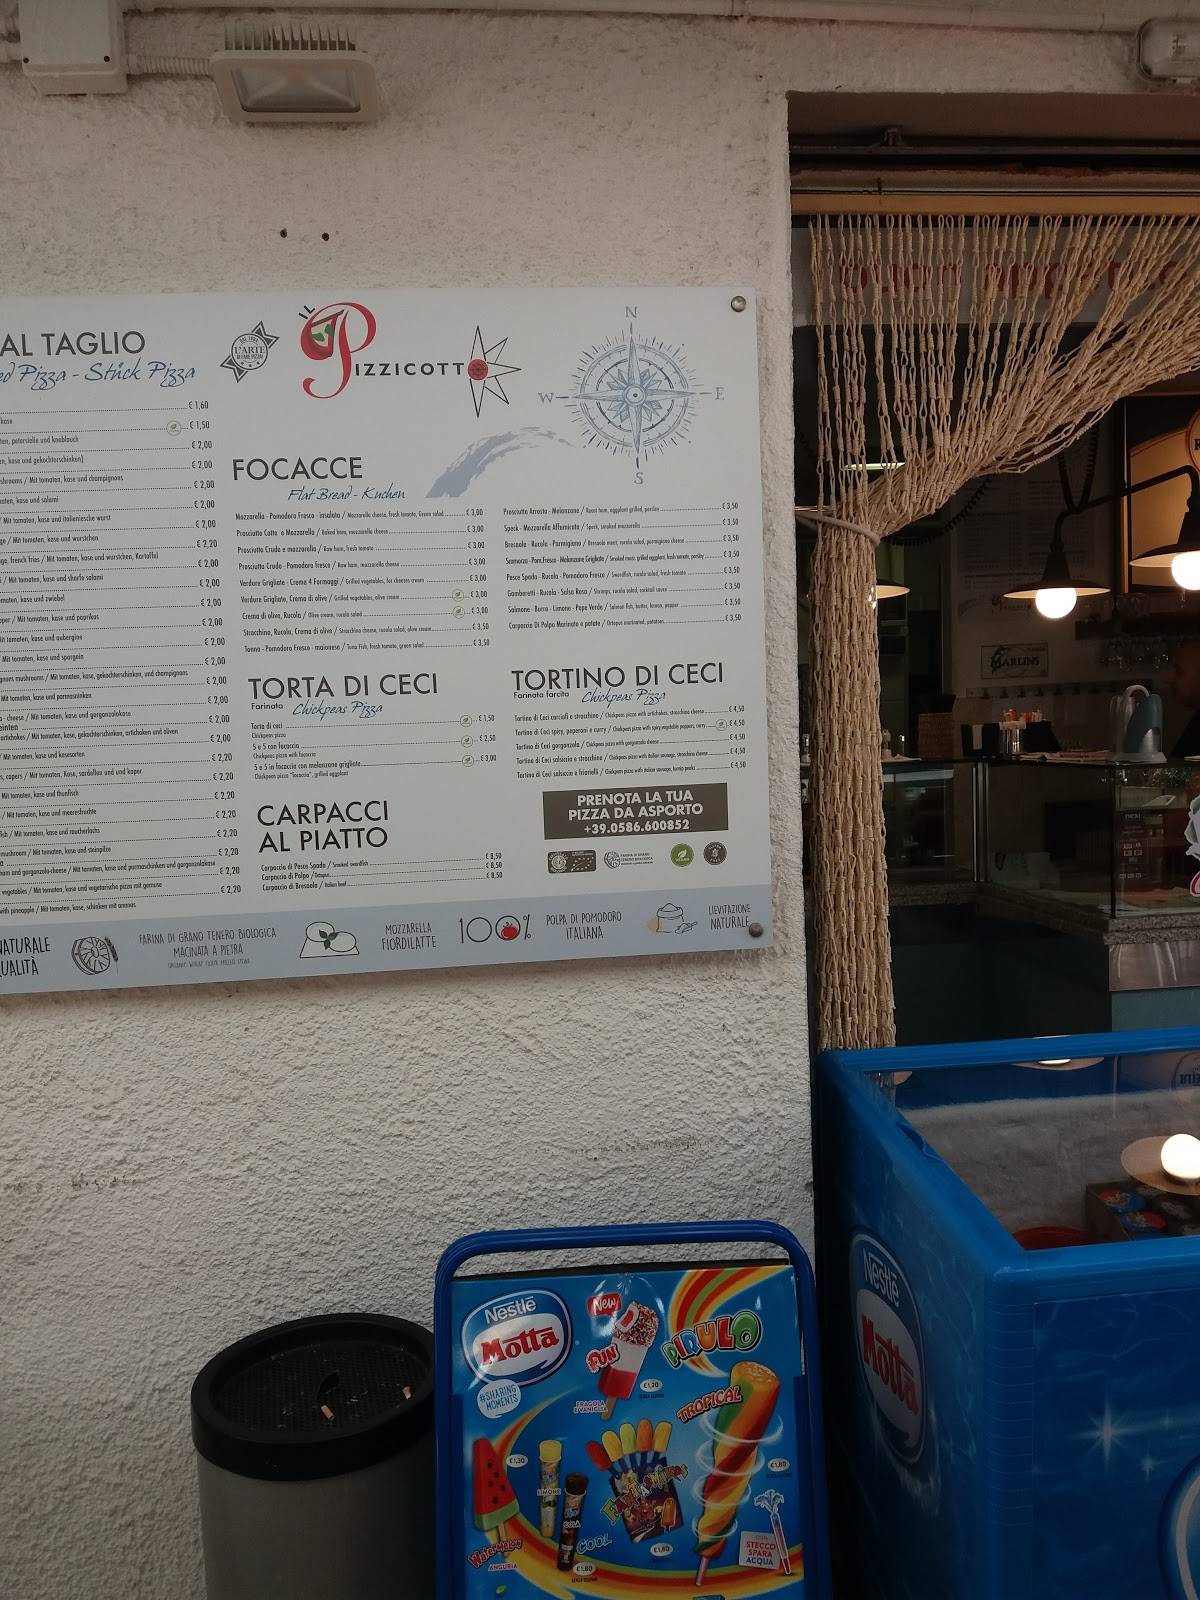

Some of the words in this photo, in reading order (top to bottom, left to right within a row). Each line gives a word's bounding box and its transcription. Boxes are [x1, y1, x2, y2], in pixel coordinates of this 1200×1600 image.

[298, 304, 316, 319] IL
[625, 306, 637, 318] N
[0, 333, 33, 356] AL
[41, 331, 145, 356] TAGLIO
[18, 364, 66, 390] Pizza
[148, 361, 195, 387] Pizza
[537, 392, 555, 403] W
[715, 387, 724, 399] E
[195, 401, 208, 410] 1,60
[196, 421, 210, 430] 1,50
[198, 441, 212, 449] 2,00
[233, 457, 362, 480] FOCACCE
[634, 472, 643, 485] S
[288, 485, 315, 500] Flat
[317, 485, 351, 500] Bread
[361, 483, 405, 499] Kuchen
[504, 524, 519, 532] Speck
[309, 576, 312, 584] 4
[476, 574, 487, 582] 3,00
[512, 666, 625, 691] TORTINO
[635, 665, 658, 685] DI
[669, 662, 723, 685] CECI
[248, 676, 334, 700] TORTA
[344, 675, 369, 696] DI
[380, 673, 438, 695] CECI
[513, 691, 544, 699] Farinata
[581, 688, 633, 708] Chickpeas
[636, 689, 666, 705] Pizza
[251, 702, 283, 710] Farinata
[292, 699, 347, 721] Chickpeas
[351, 700, 383, 718] Pizza
[734, 705, 744, 713] 4,50
[217, 734, 231, 743] 2,00
[220, 791, 235, 800] 2,20
[577, 793, 641, 807] PRENOTA
[646, 792, 662, 803] LA
[666, 790, 693, 801] TUA
[257, 800, 389, 826] CARPACCI
[569, 807, 610, 821] PIZZA
[614, 807, 634, 818] DA
[638, 803, 703, 817] ASPORTO
[584, 819, 689, 834] +39.0586.600852
[259, 832, 291, 853] AL
[300, 827, 388, 851] PIATTO
[708, 903, 751, 916] LIEVITAZIONE
[546, 914, 568, 926] POLPA
[570, 913, 579, 924] DI
[581, 910, 622, 923] POMODORO
[710, 916, 750, 930] NATURALE
[139, 934, 164, 945] FARINA
[168, 933, 175, 943] DI
[179, 932, 204, 943] GRANO
[208, 930, 235, 941] TENERO
[239, 928, 277, 940] BIOLOGICA
[385, 922, 432, 935] MOZZARELLA
[566, 926, 604, 941] ITALIANA
[382, 935, 437, 951] FIORDILATTE
[173, 945, 208, 959] MACINATA
[213, 945, 217, 955] A
[220, 944, 243, 956] PIETRA
[0, 955, 39, 978] UALITÀ
[592, 1297, 618, 1315] New
[481, 1326, 559, 1366] Motta
[586, 1344, 620, 1373] FUN
[862, 1315, 918, 1415] Motta
[480, 1385, 516, 1402] #SHARING
[486, 1394, 518, 1410] MOMENTS
[677, 1386, 742, 1423] TROPICAL
[537, 1488, 561, 1496] LIMONE
[576, 1533, 612, 1555] COOL
[746, 1541, 775, 1550] STECCO
[748, 1548, 772, 1558] SPARA
[746, 1557, 774, 1566] ACQUA
